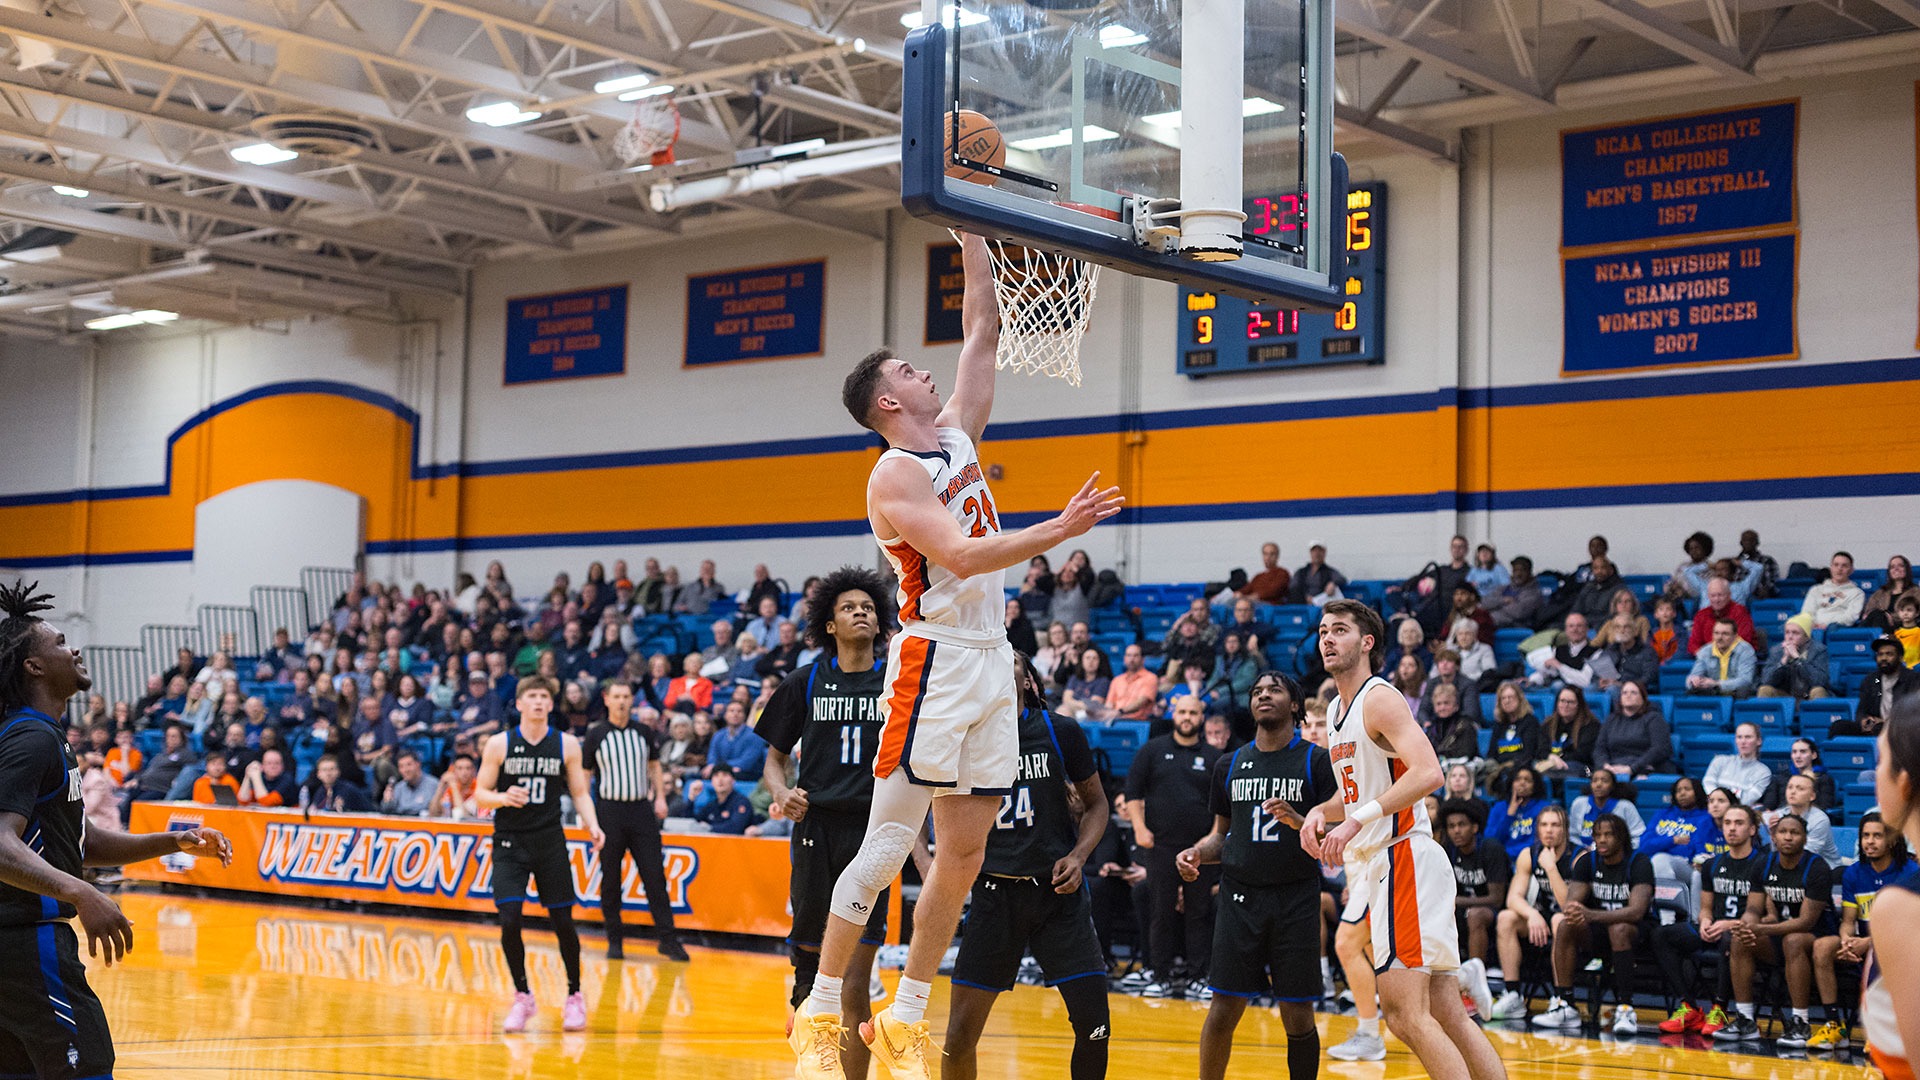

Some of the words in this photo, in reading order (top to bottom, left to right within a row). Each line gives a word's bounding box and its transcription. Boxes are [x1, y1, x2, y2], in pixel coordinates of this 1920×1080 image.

[1595, 134, 1643, 156] NCAA
[1651, 118, 1761, 149] COLLEGIATE
[1624, 149, 1729, 178] CHAMPIONS
[1586, 184, 1643, 209] MEN'S
[1651, 170, 1770, 201] BASKETBALL
[1657, 204, 1698, 226] 1957
[1594, 261, 1644, 283] NCAA
[1652, 251, 1731, 278] DIVISION
[1740, 248, 1762, 268] III
[1624, 278, 1730, 306] CHAMPIONS
[1197, 315, 1213, 344] 9
[1597, 308, 1680, 334] WOMEN'S
[1689, 301, 1758, 325] SOCCER
[1654, 333, 1699, 355] 2007
[813, 696, 854, 721] NORTH
[859, 697, 884, 721] PAR
[841, 726, 861, 764] 11
[504, 757, 535, 775] NORTH
[537, 757, 561, 776] PARK
[1017, 752, 1050, 780] PARK
[1232, 777, 1268, 802] NORTH
[1272, 777, 1304, 802] PARK
[995, 787, 1035, 829] 24
[258, 823, 477, 897] WHEATON
